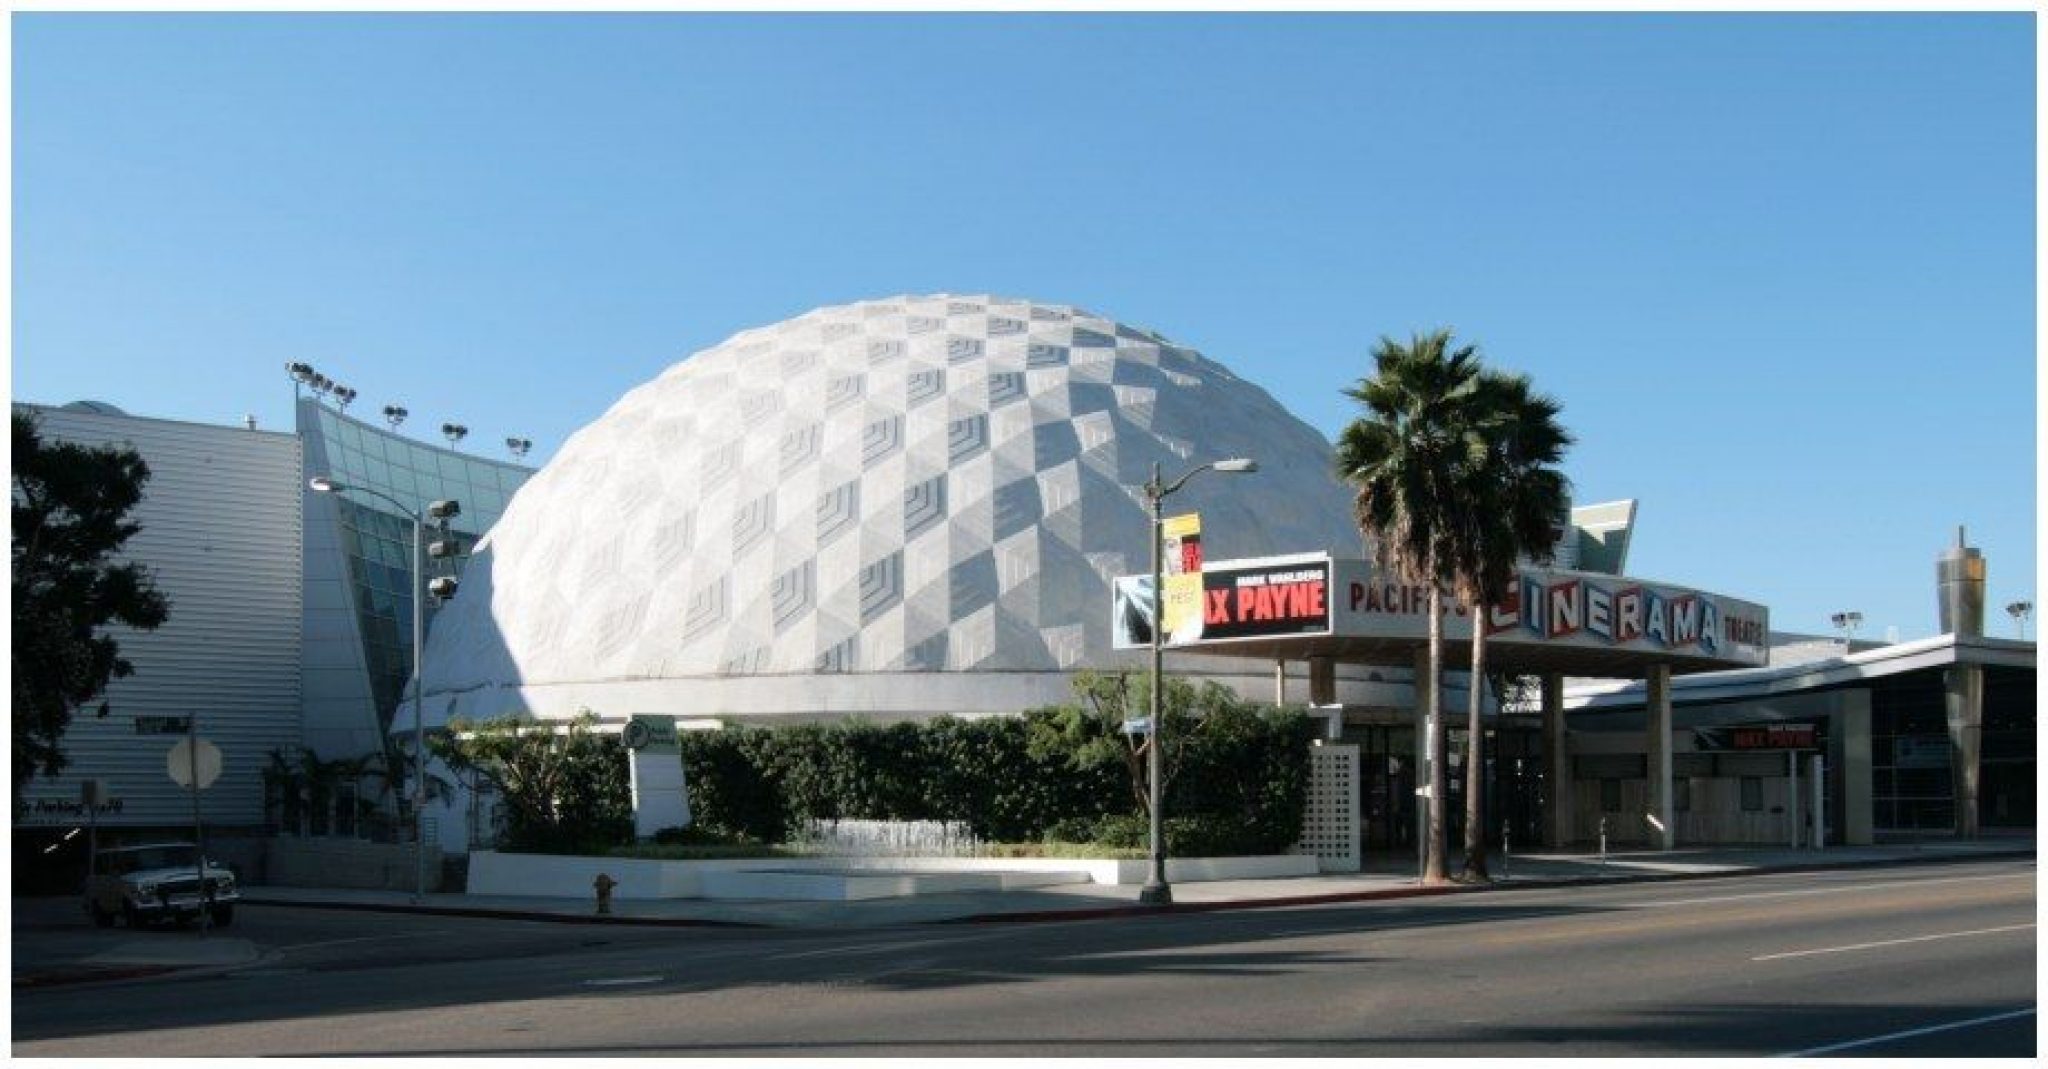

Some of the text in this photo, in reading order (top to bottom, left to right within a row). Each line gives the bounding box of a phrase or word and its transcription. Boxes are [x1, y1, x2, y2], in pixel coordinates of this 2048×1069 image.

[1203, 581, 1325, 625] AX PAYNE
[1490, 579, 1719, 651] CINERAMA
